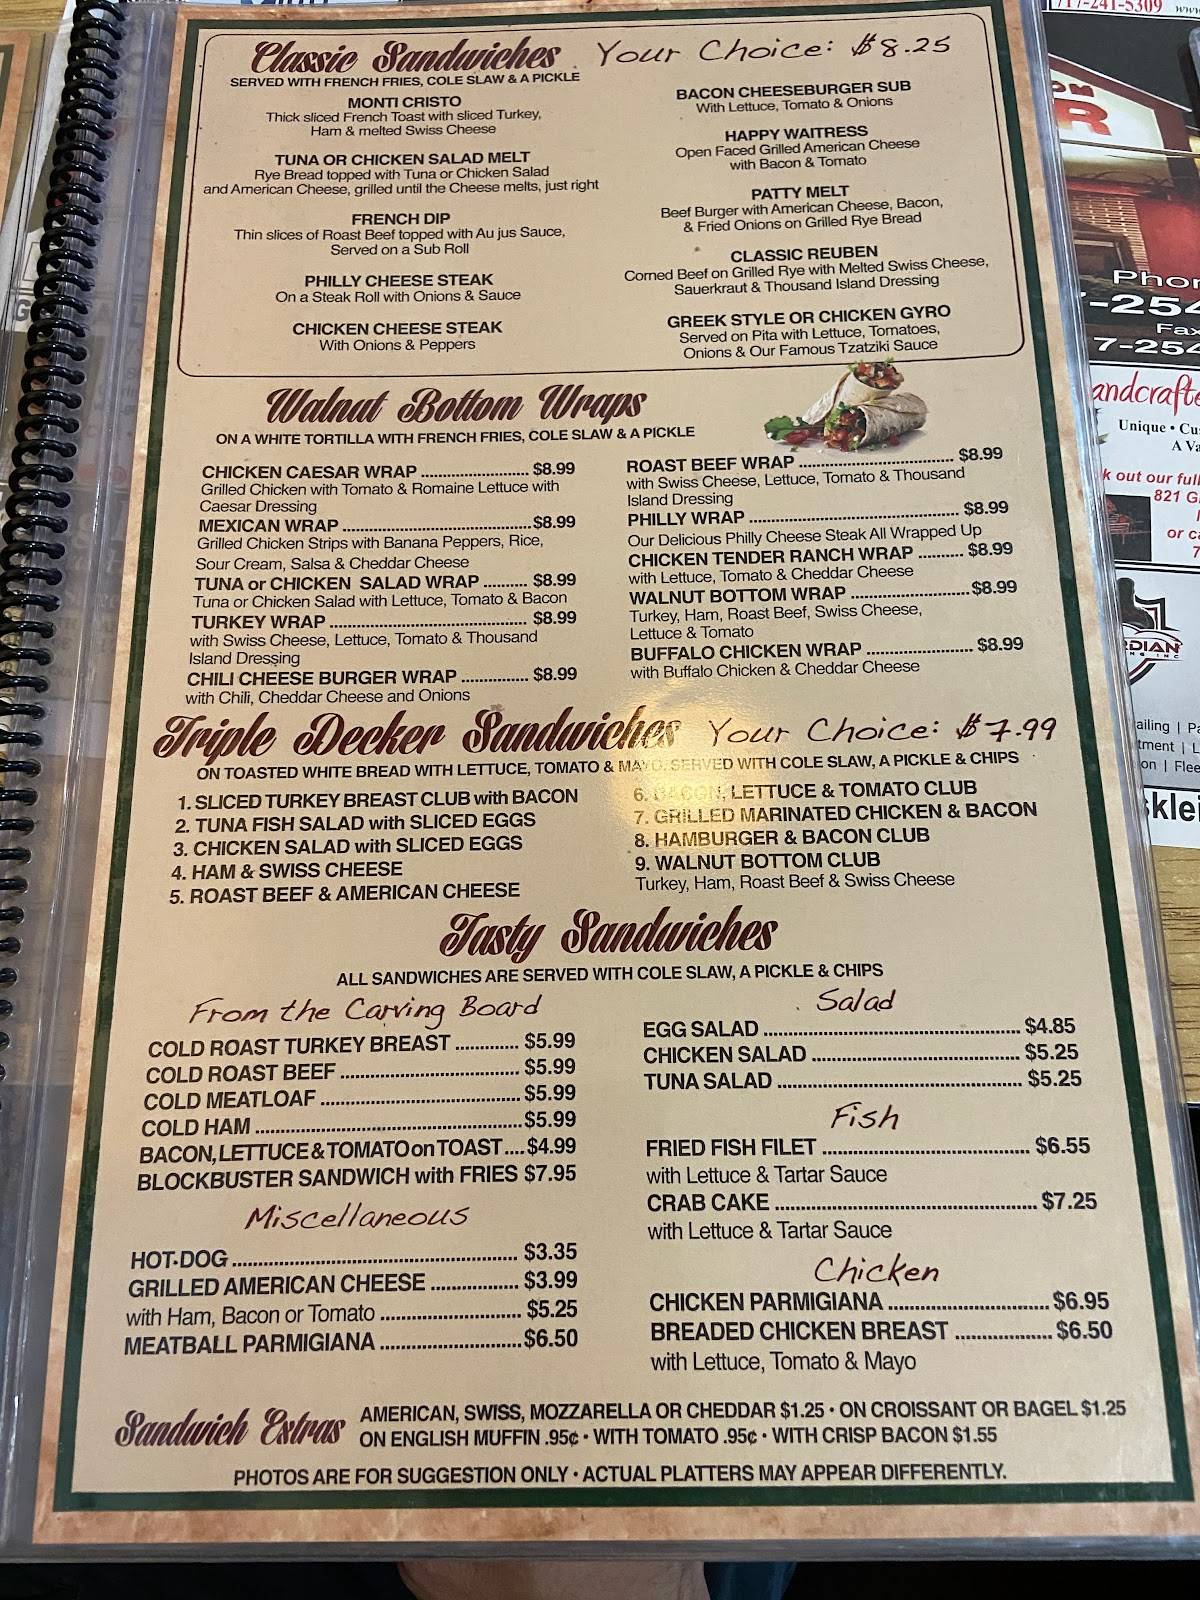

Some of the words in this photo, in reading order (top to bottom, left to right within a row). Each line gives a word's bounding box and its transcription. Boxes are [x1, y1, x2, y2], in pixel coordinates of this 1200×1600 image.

[251, 40, 358, 73] Classic
[372, 35, 561, 73] Sandwiches
[597, 39, 680, 66] Your
[699, 37, 833, 61] Choice:
[851, 32, 950, 57] $8.25
[230, 77, 284, 87] SERVED
[287, 77, 320, 87] WITH
[324, 77, 378, 87] FRENCH
[382, 76, 423, 87] FRIES,
[426, 75, 463, 85] COLE
[466, 74, 505, 84] SLAW
[507, 74, 516, 83] &
[519, 73, 529, 83] A
[532, 72, 579, 82] PICKLE
[676, 87, 734, 100] BACON
[738, 82, 872, 96] CHEESEBURGER
[877, 80, 911, 92] SUB
[348, 97, 398, 108] MONTI
[402, 95, 461, 108] CRISTO
[725, 128, 780, 141] HAPPY
[783, 125, 868, 139] WAITRESS
[274, 154, 319, 165] TUNA
[323, 154, 347, 165] OR
[351, 153, 424, 165] CHICKEN
[428, 152, 483, 164] SALAD
[488, 151, 530, 163] MELT
[352, 213, 419, 225] FRENCH
[424, 212, 450, 224] DIP
[330, 243, 377, 255] Served
[381, 246, 398, 255] on
[401, 246, 410, 254] a
[413, 243, 440, 254] Sub
[444, 242, 469, 254] Roll
[730, 248, 803, 262] CLASSIC
[807, 245, 878, 260] REUBEN
[305, 275, 361, 287] PHILLY
[365, 274, 433, 287] CHEESE
[437, 273, 493, 286] STEAK
[674, 282, 747, 295] Sauerkraut
[751, 281, 761, 292] &
[764, 278, 832, 292] Thousand
[836, 276, 875, 289] Island
[879, 274, 939, 287] Dressing
[667, 314, 727, 328] GREEK
[730, 312, 785, 326] STYLE
[789, 311, 814, 324] OR
[818, 307, 896, 323] CHICKEN
[900, 304, 951, 319] GYRO
[266, 386, 390, 423] Walnut
[397, 387, 524, 423] Bottom
[538, 384, 647, 425] Wraps
[1118, 419, 1166, 435] Unique
[1172, 440, 1182, 451] A
[202, 465, 281, 478] CHICKEN
[286, 465, 359, 479] CAESAR
[363, 465, 417, 478] WRAP
[532, 461, 575, 475] $8.99
[626, 458, 687, 473] ROAST
[691, 457, 737, 471] BEEF
[740, 455, 794, 469] WRAP
[958, 446, 1002, 463] $8.99
[1116, 471, 1141, 482] out
[1146, 473, 1173, 484] our
[1154, 489, 1180, 503] 821
[198, 518, 280, 532] MEXICAN
[284, 519, 338, 532] WRAP
[533, 515, 575, 529] $8.99
[628, 511, 686, 526] PHILLY
[690, 510, 744, 524] WRAP
[963, 500, 1008, 516] $8.99
[1167, 529, 1184, 539] or
[153, 711, 276, 765] Triple
[292, 708, 446, 756] Decker
[461, 704, 682, 753] Sandwiches
[708, 717, 789, 746] Your
[807, 716, 939, 743] Choice:
[955, 712, 1056, 742] $7.99
[171, 865, 186, 880] 4.
[192, 864, 235, 879] HAM
[240, 863, 253, 879] &
[259, 862, 320, 878] SWISS
[325, 861, 402, 877] CHEESE
[635, 856, 649, 871] 9.
[654, 854, 736, 870] WALNUT
[740, 852, 822, 869] BOTTOM
[827, 851, 880, 867] CLUB
[439, 912, 546, 964] Tasty
[560, 904, 778, 953] Sandwiches
[816, 987, 896, 1012] Salad
[188, 997, 268, 1023] From
[280, 998, 330, 1022] the
[345, 996, 445, 1028] Carving
[458, 993, 542, 1017] Board
[643, 1020, 686, 1038] EGG
[691, 1020, 758, 1037] SALAD
[1024, 1016, 1075, 1035] $4.85
[143, 1092, 201, 1111] COLD
[206, 1089, 316, 1108] MEATLOAF
[524, 1083, 575, 1102] $5.99
[830, 1101, 898, 1130] Fish
[647, 1193, 705, 1212] CRAB
[711, 1193, 769, 1211] CAKE
[1041, 1190, 1097, 1211] $7.25
[244, 1202, 470, 1229] Miscellaneous
[814, 1252, 938, 1287] Chicken
[649, 1292, 744, 1311] CHICKEN
[750, 1291, 883, 1310] PARMIGIANA
[1052, 1290, 1109, 1312] $6.95
[124, 1334, 237, 1355] MEATBALL
[243, 1331, 375, 1353] PARMIGIANA
[523, 1327, 578, 1349] $6.50
[114, 1407, 250, 1446] Sandwich
[260, 1407, 346, 1445] Extras
[234, 1468, 309, 1486] PHOTOS
[312, 1468, 350, 1485] ARE
[355, 1467, 392, 1484] FOR
[397, 1466, 515, 1484] SUGGESTION
[520, 1465, 568, 1483] ONLY
[582, 1465, 656, 1482] ACTUAL
[660, 1464, 754, 1482] PLATTERS
[758, 1464, 796, 1481] MAY
[800, 1463, 876, 1480] APPEAR
[881, 1462, 1006, 1480] DIFFERENTLY.
